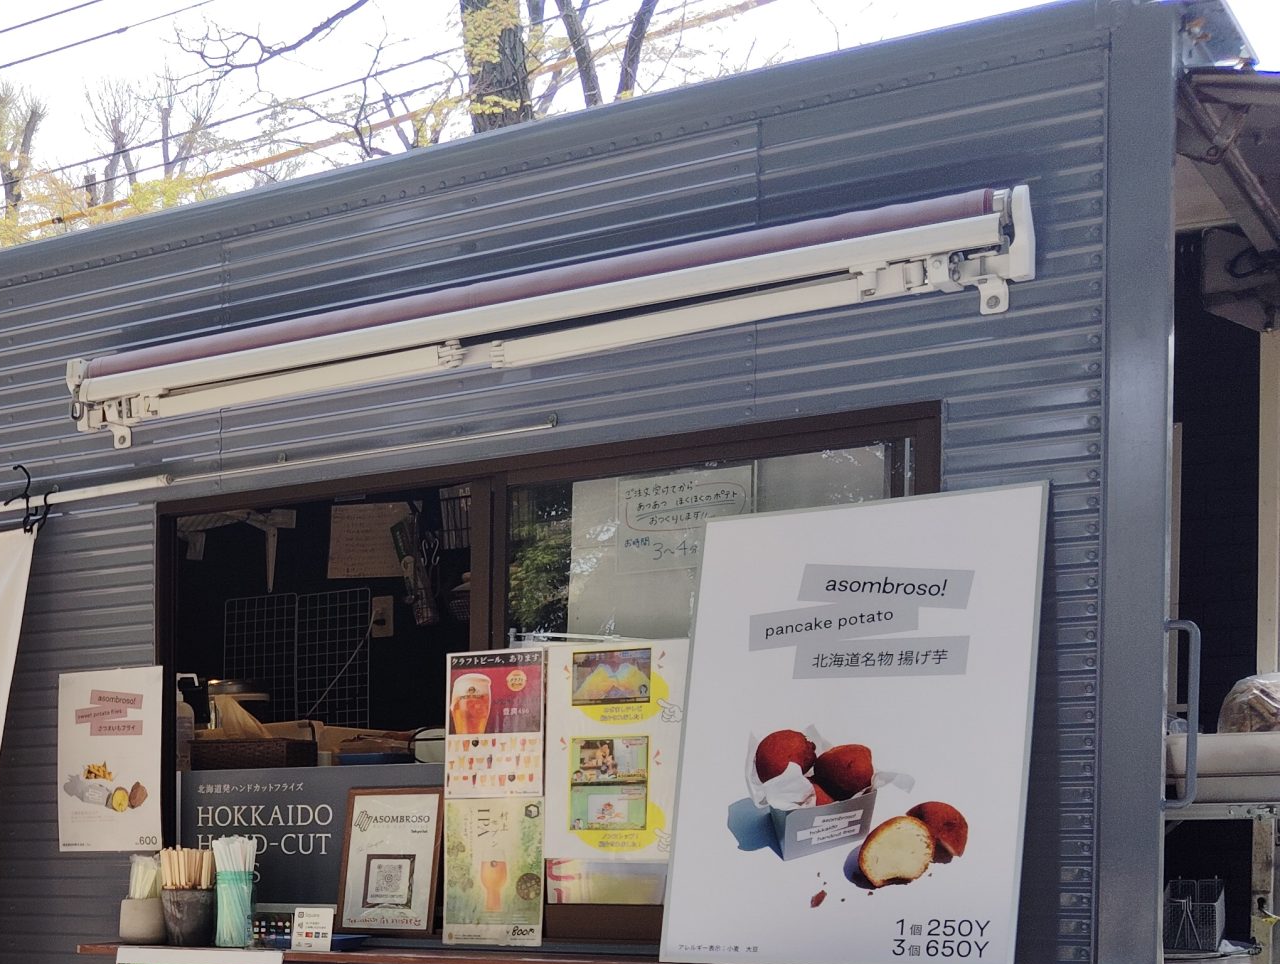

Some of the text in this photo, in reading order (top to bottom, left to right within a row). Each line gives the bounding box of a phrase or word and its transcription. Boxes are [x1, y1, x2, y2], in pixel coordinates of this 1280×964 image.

[825, 577, 948, 596] asombroso!
[765, 611, 894, 639] pancake potato
[812, 650, 949, 668] 北海道名物 揚げ芋
[98, 694, 136, 705] asombroso!
[198, 782, 304, 794] 北海道発ハンドカットフライズ
[197, 804, 333, 826] HOKKAIDO
[372, 816, 430, 824] ASOMBROSO
[139, 836, 158, 846] 600
[197, 833, 332, 855] HD-CUT
[896, 919, 990, 936] 1個 250Y
[892, 939, 990, 958] 3個 650Y
